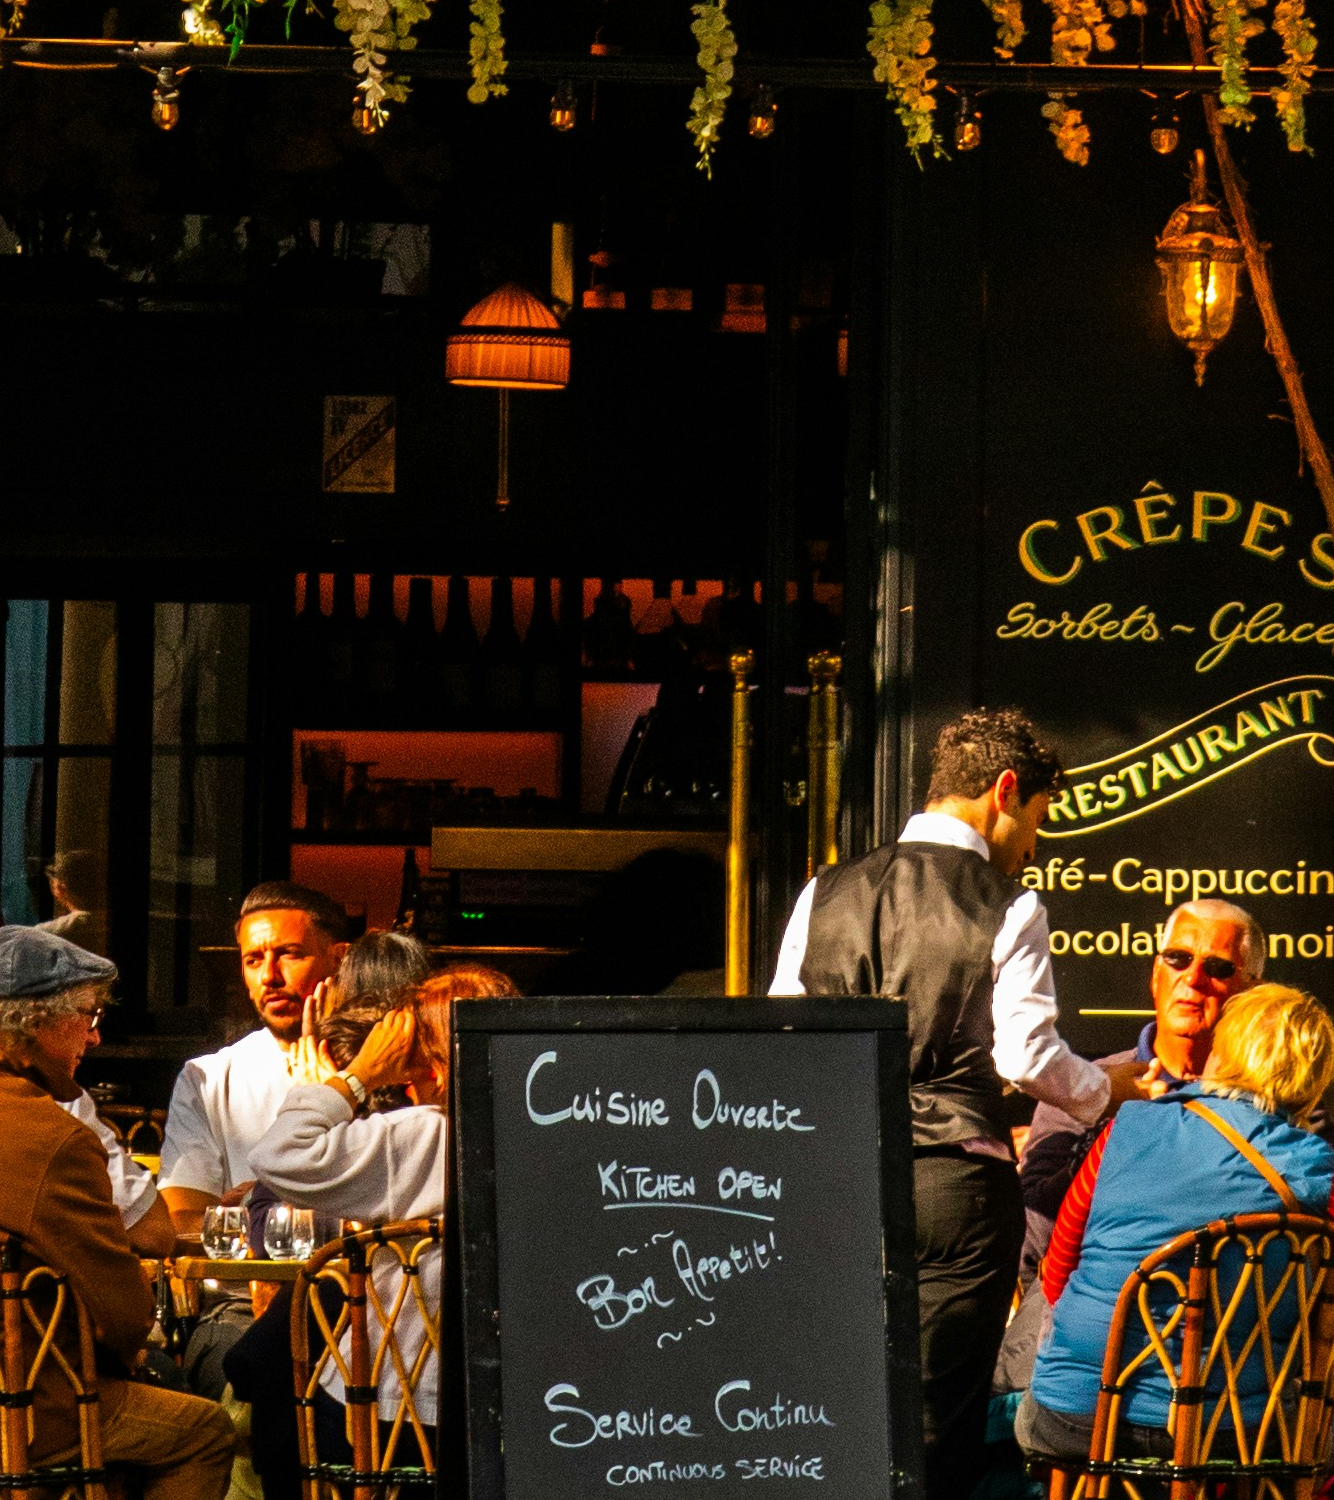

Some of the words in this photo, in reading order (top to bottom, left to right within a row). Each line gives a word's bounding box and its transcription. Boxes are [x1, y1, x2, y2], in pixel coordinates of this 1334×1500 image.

[995, 601, 1160, 643] Sorbets
[1046, 688, 1324, 824] RESTAURANT
[525, 1050, 670, 1126] Cuisine
[691, 1068, 816, 1131] Ouverte
[718, 1166, 782, 1200] OPEN
[576, 1274, 675, 1330] Bon
[715, 1379, 836, 1432] Continu
[605, 1460, 727, 1487] CONTINUOUS
